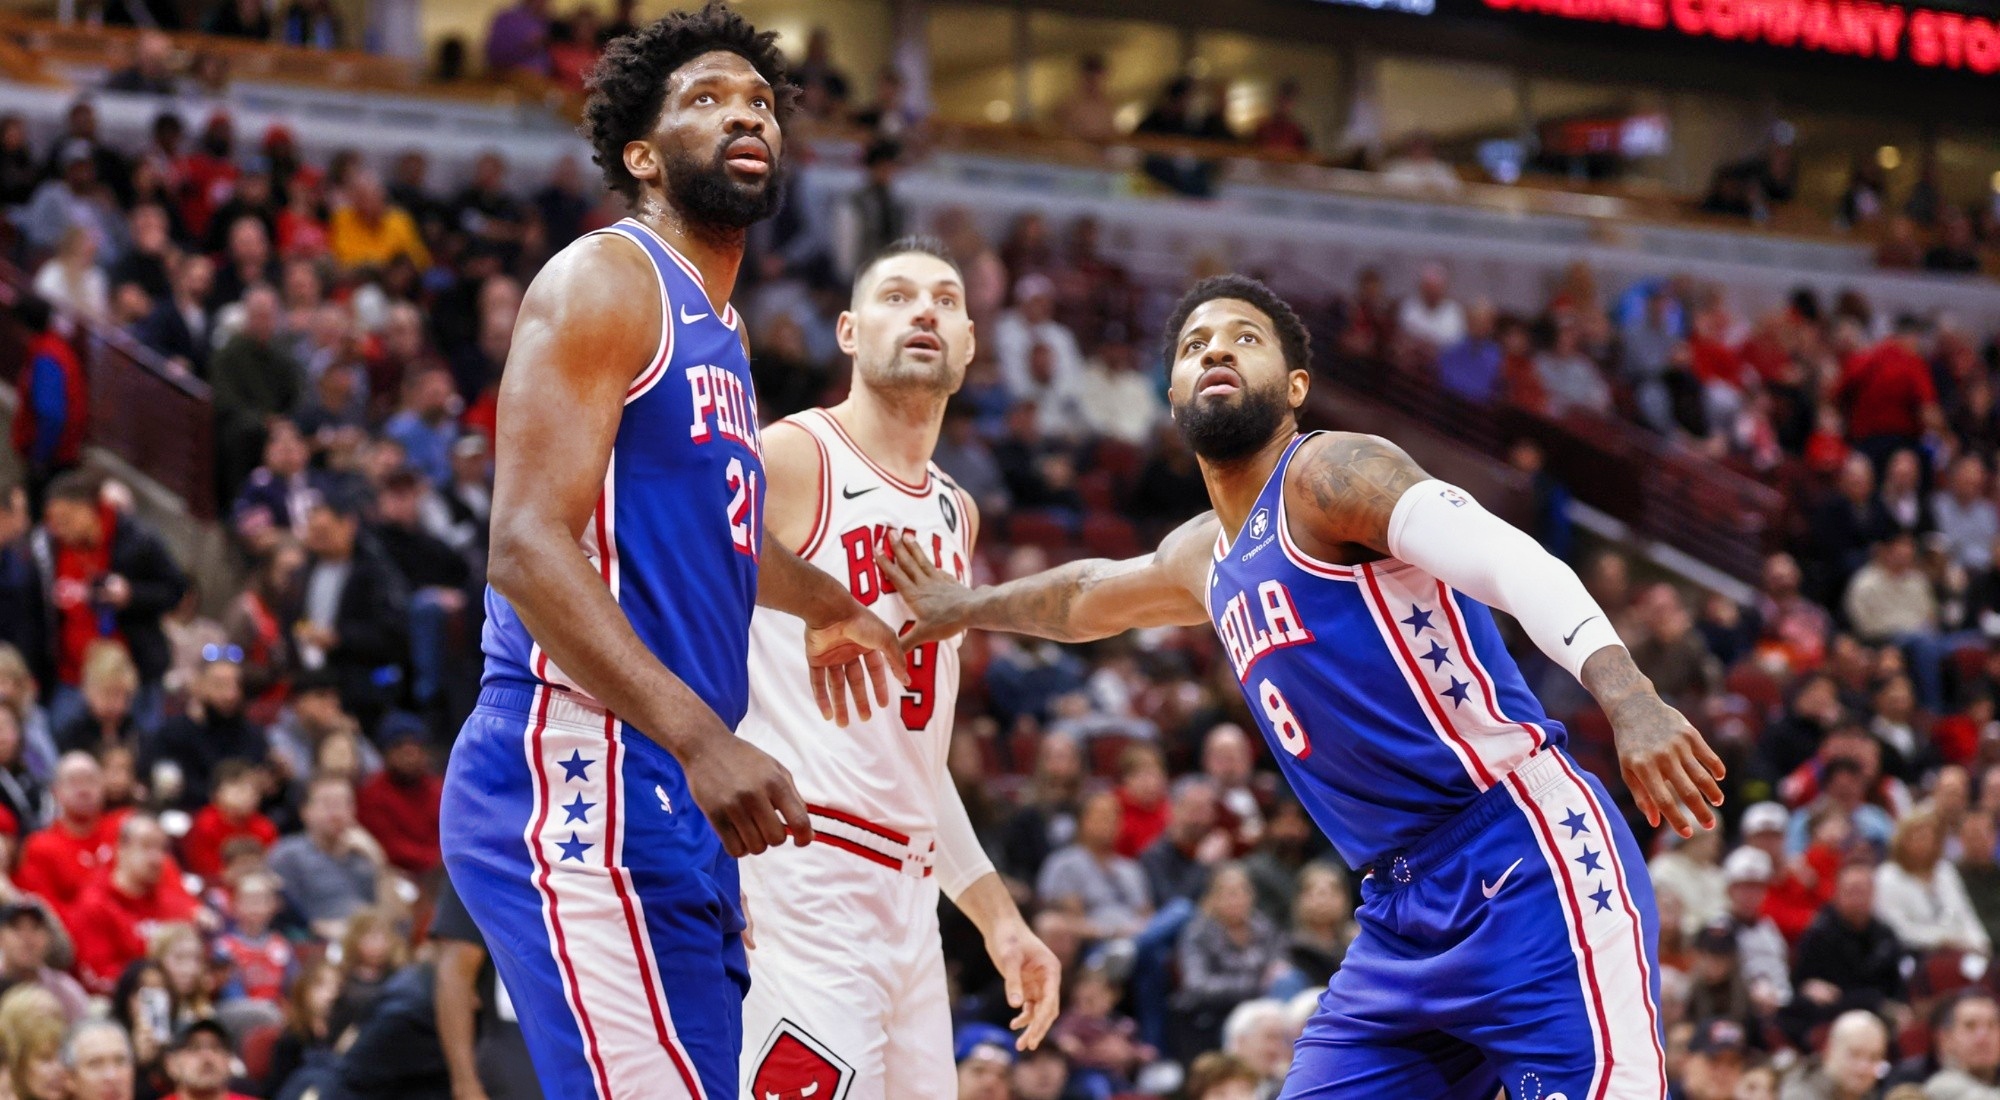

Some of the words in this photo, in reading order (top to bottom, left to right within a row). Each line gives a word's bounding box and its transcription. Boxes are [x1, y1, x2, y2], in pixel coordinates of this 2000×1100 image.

[726, 457, 760, 565] 21
[1242, 533, 1275, 562] crypto.com
[1218, 579, 1317, 687] HILA
[1259, 677, 1313, 761] 8
